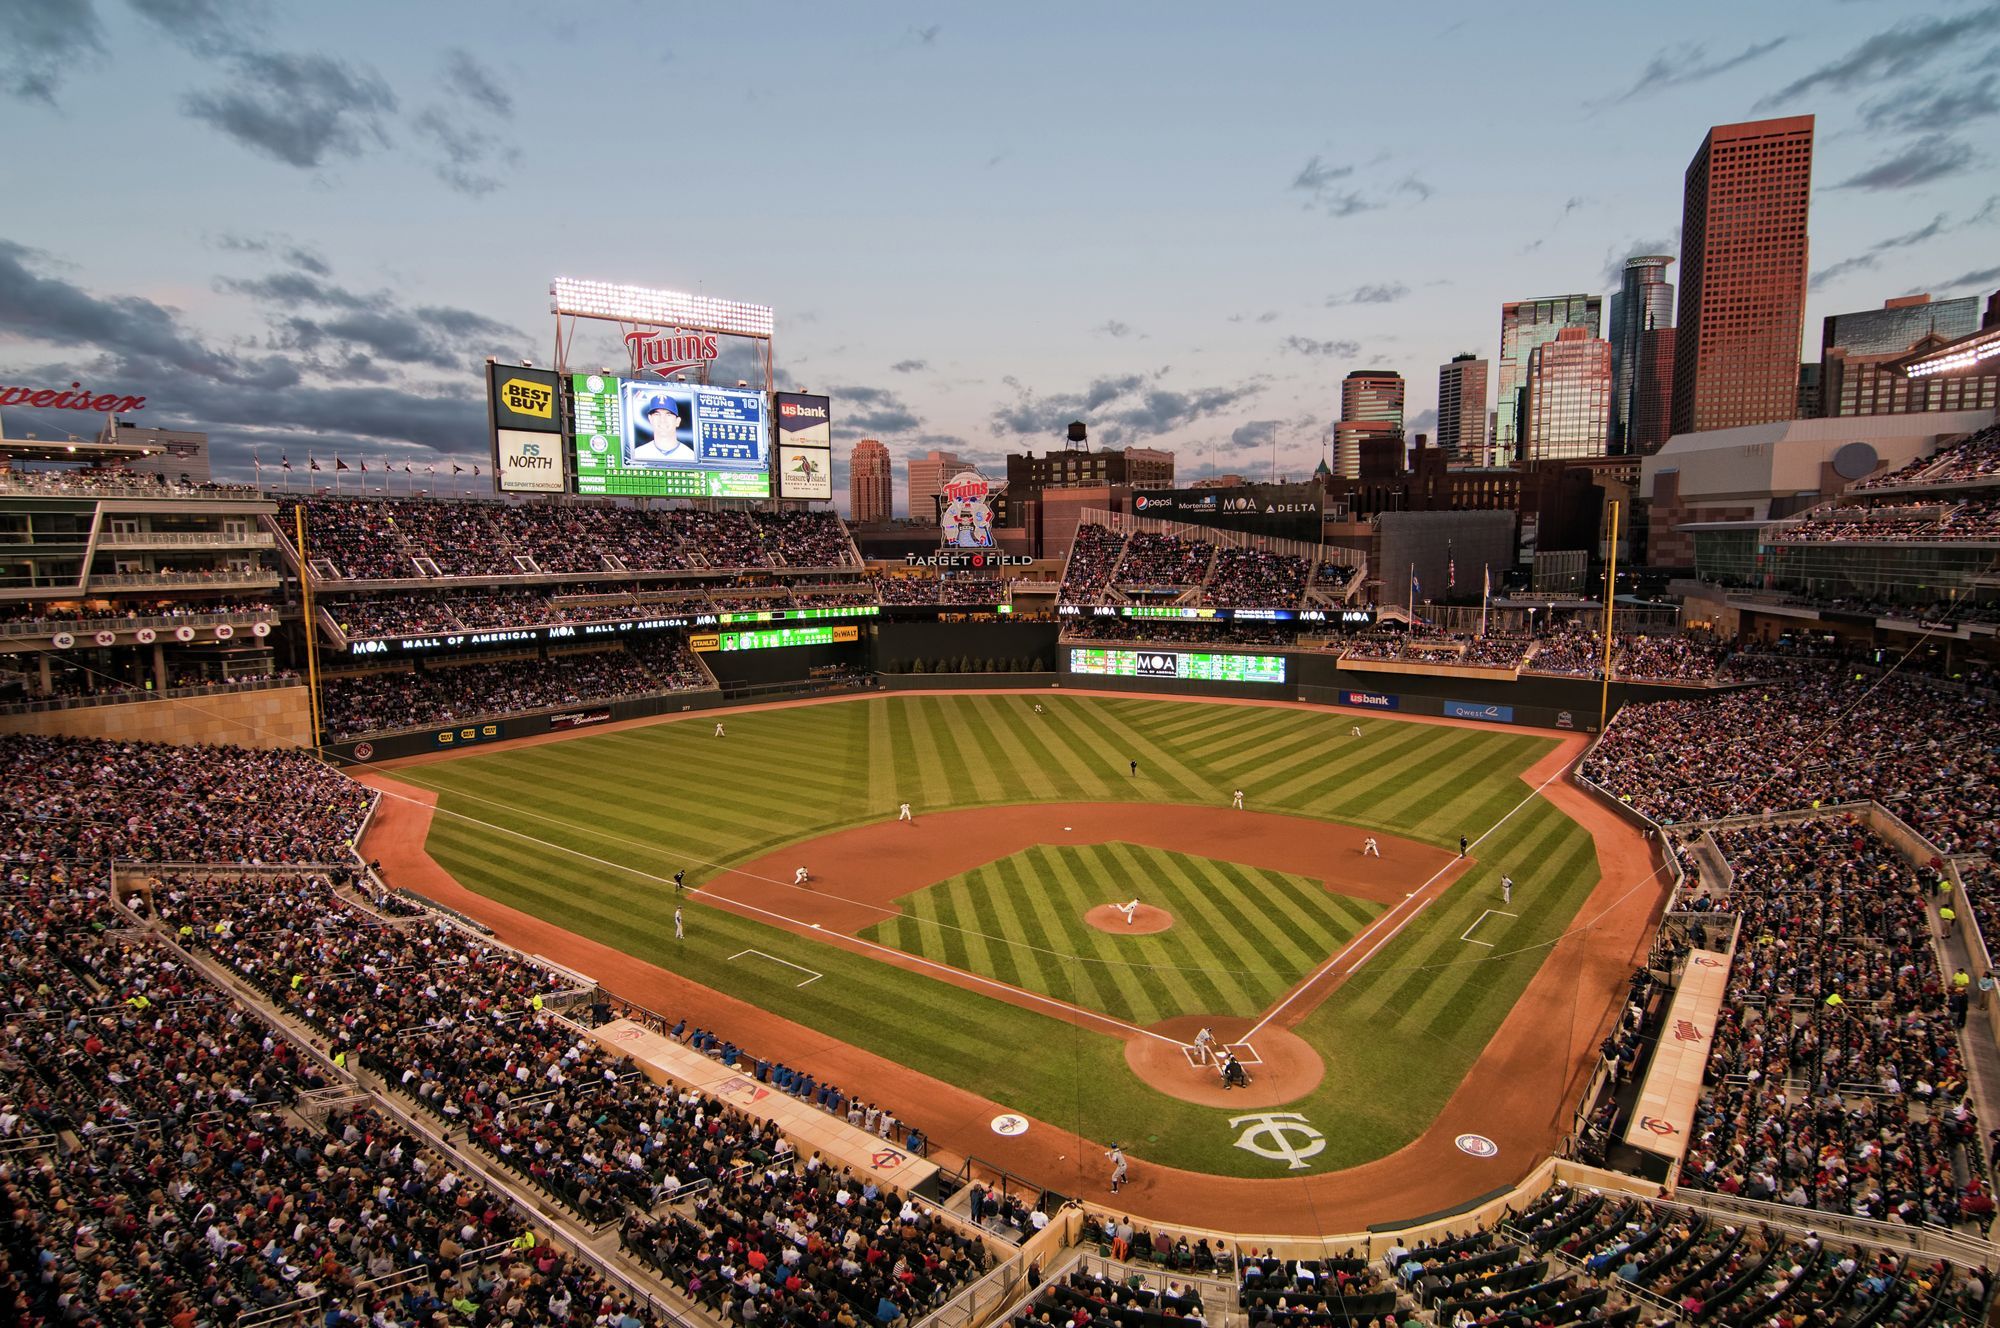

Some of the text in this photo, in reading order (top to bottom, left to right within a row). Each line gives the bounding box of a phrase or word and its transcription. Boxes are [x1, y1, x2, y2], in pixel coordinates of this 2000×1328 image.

[624, 327, 719, 372] Twins
[508, 384, 551, 402] BEST
[510, 397, 548, 412] BUY
[700, 398, 758, 409] YOUNG 10
[522, 443, 540, 456] FS
[508, 455, 552, 470] NORTH
[784, 472, 807, 482] Treasure
[943, 480, 989, 502] Twins
[1148, 497, 1173, 507] pepsi
[1178, 502, 1216, 510] Mortenson
[1277, 503, 1316, 512] DELTA
[906, 555, 1033, 566] TARGET FIELD
[1059, 606, 1080, 615] MOA
[1094, 607, 1116, 616] MOA
[696, 615, 717, 625] MOA
[1300, 611, 1326, 621] MOA
[1342, 611, 1369, 622] MOA
[549, 626, 575, 638] MOA
[586, 624, 615, 634] MALL
[619, 622, 633, 630] OF
[100, 634, 112, 642] 34
[141, 632, 152, 640] 14
[183, 630, 189, 638] 6
[59, 637, 71, 645] 42
[403, 639, 440, 648] MALL
[447, 636, 464, 645] OF
[692, 639, 717, 647] STANLEY
[353, 641, 388, 654] MOA
[1137, 655, 1175, 670] MOA
[1456, 707, 1483, 717] Qwest
[573, 714, 610, 725] Budweiser
[845, 1235, 851, 1243] 3
